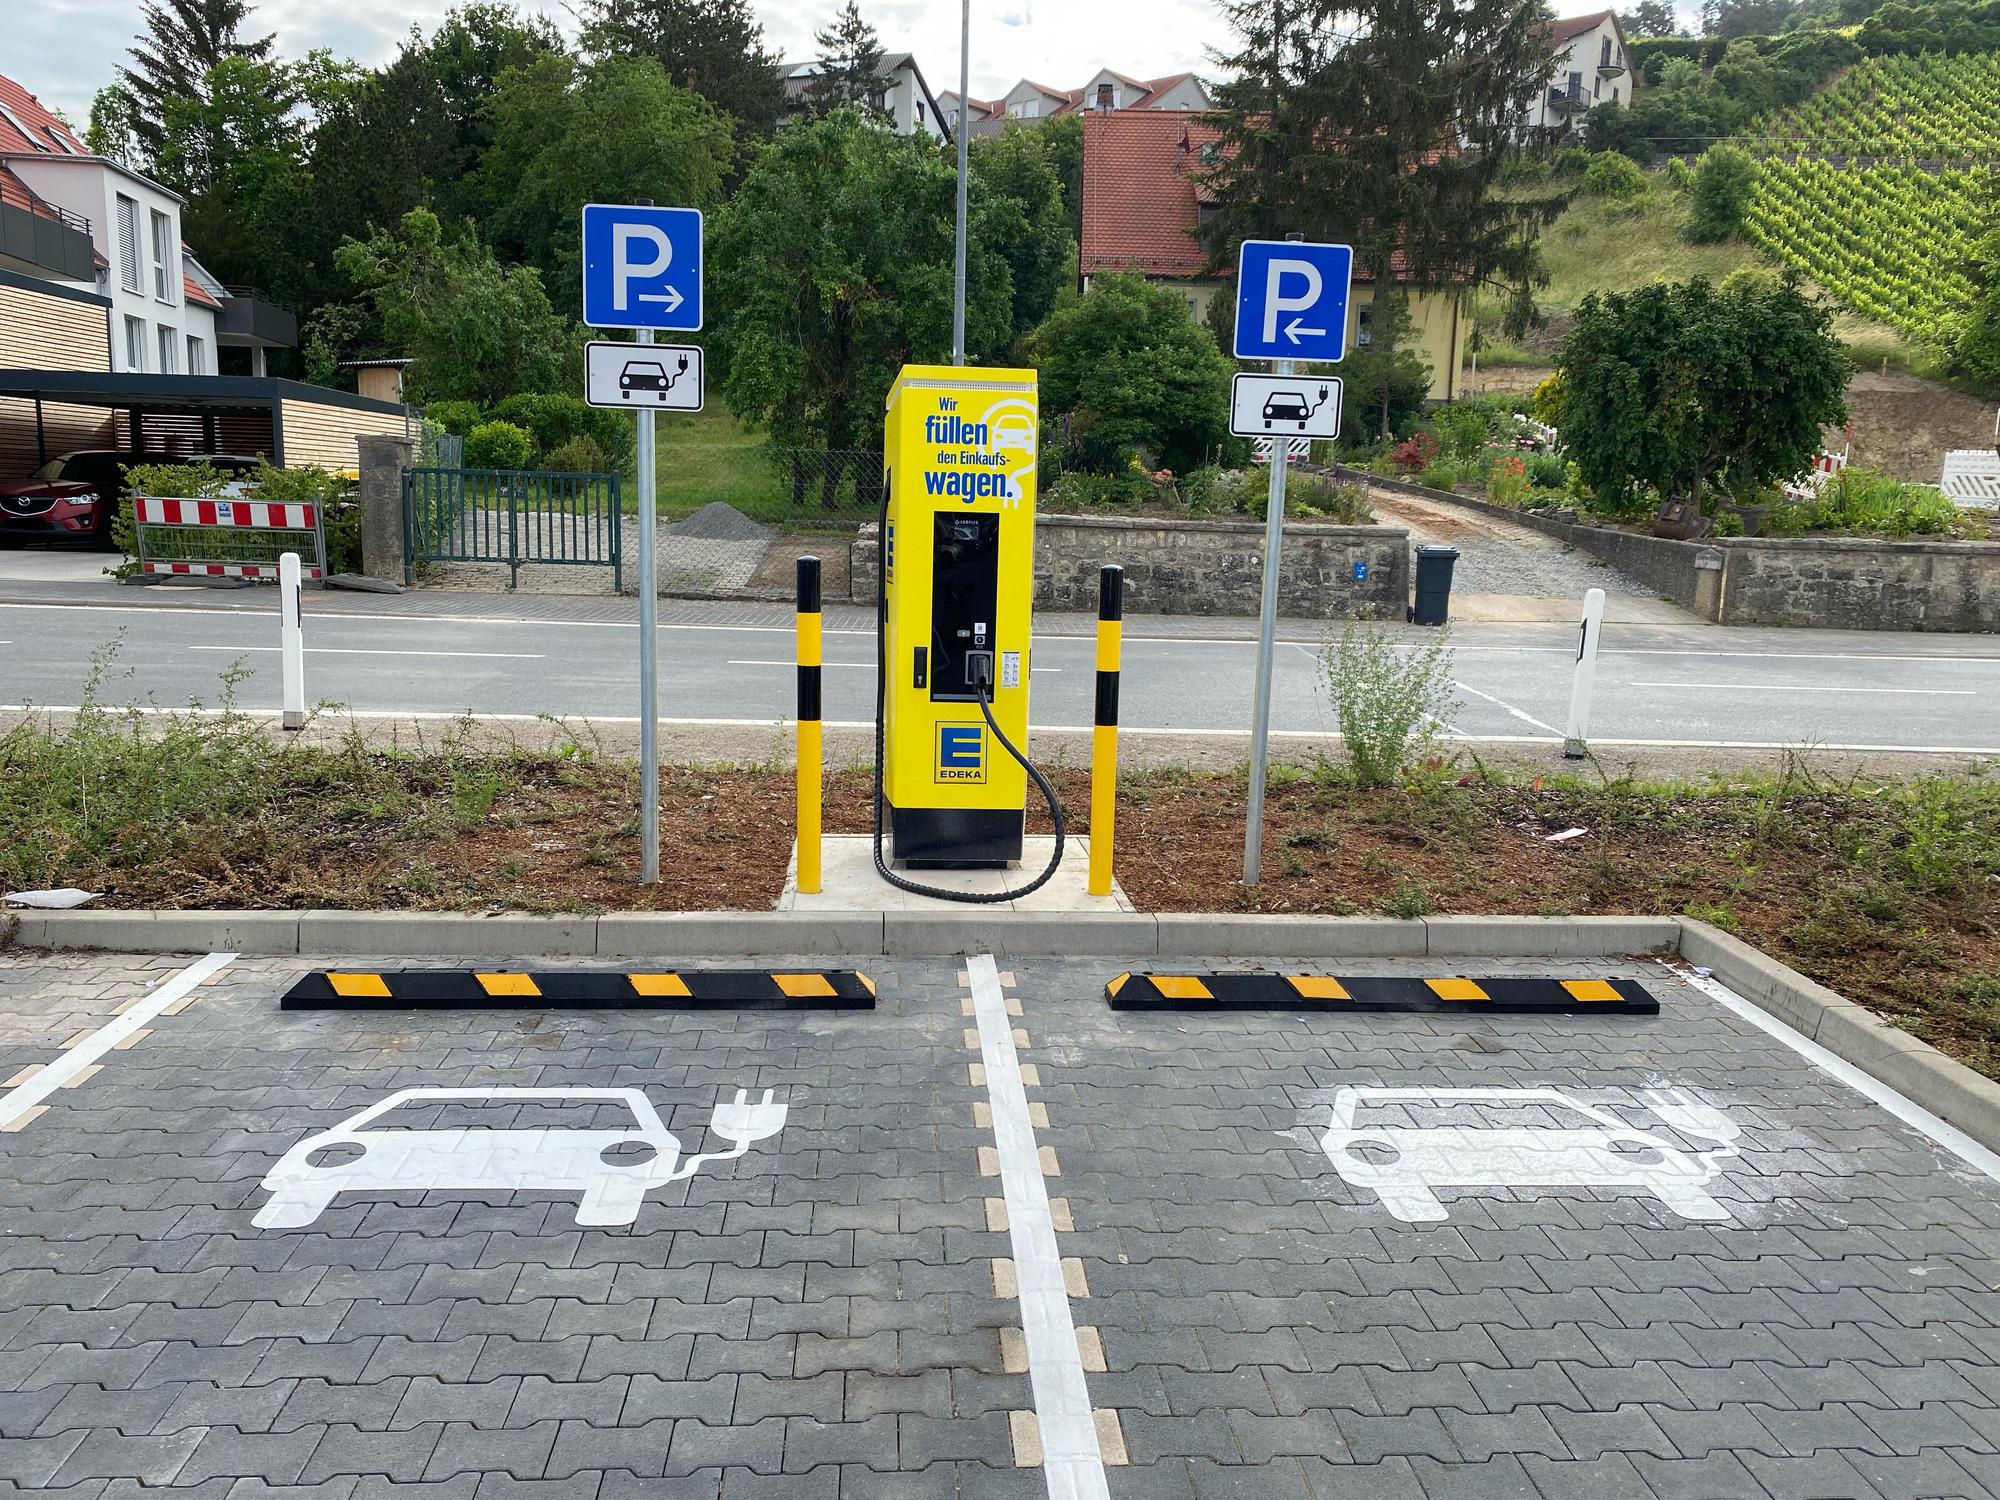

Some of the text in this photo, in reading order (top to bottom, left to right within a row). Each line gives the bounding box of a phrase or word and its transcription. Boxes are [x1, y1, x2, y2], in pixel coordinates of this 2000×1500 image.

[613, 223, 673, 311] P
[1262, 259, 1323, 343] P
[939, 397, 958, 411] Wir
[925, 415, 988, 445] füllen
[937, 450, 1011, 466] den Einkaufs-
[924, 471, 1013, 504] wagen.
[941, 727, 981, 767] E
[940, 770, 981, 779] EDEKA
